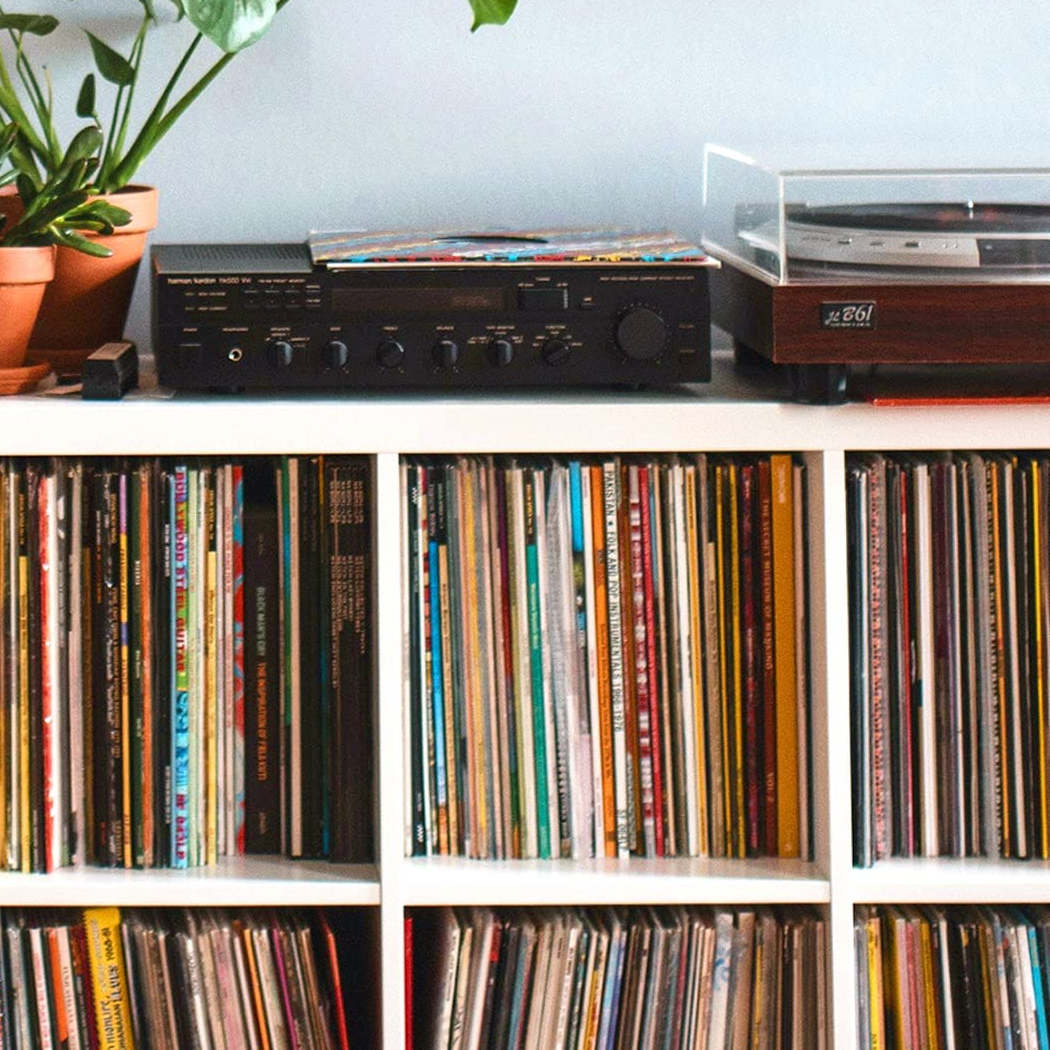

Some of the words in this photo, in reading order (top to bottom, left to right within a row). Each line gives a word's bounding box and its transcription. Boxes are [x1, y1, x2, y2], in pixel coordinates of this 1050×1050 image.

[605, 471, 616, 517] PAKISTAN
[175, 472, 185, 561] BOLLYWOOD
[607, 531, 618, 555] FOLK
[176, 567, 185, 610] STEEL
[609, 558, 620, 577] AND
[609, 581, 620, 600] POP
[176, 618, 185, 672] GUITAR
[610, 602, 623, 680] INSTRUMENTALS
